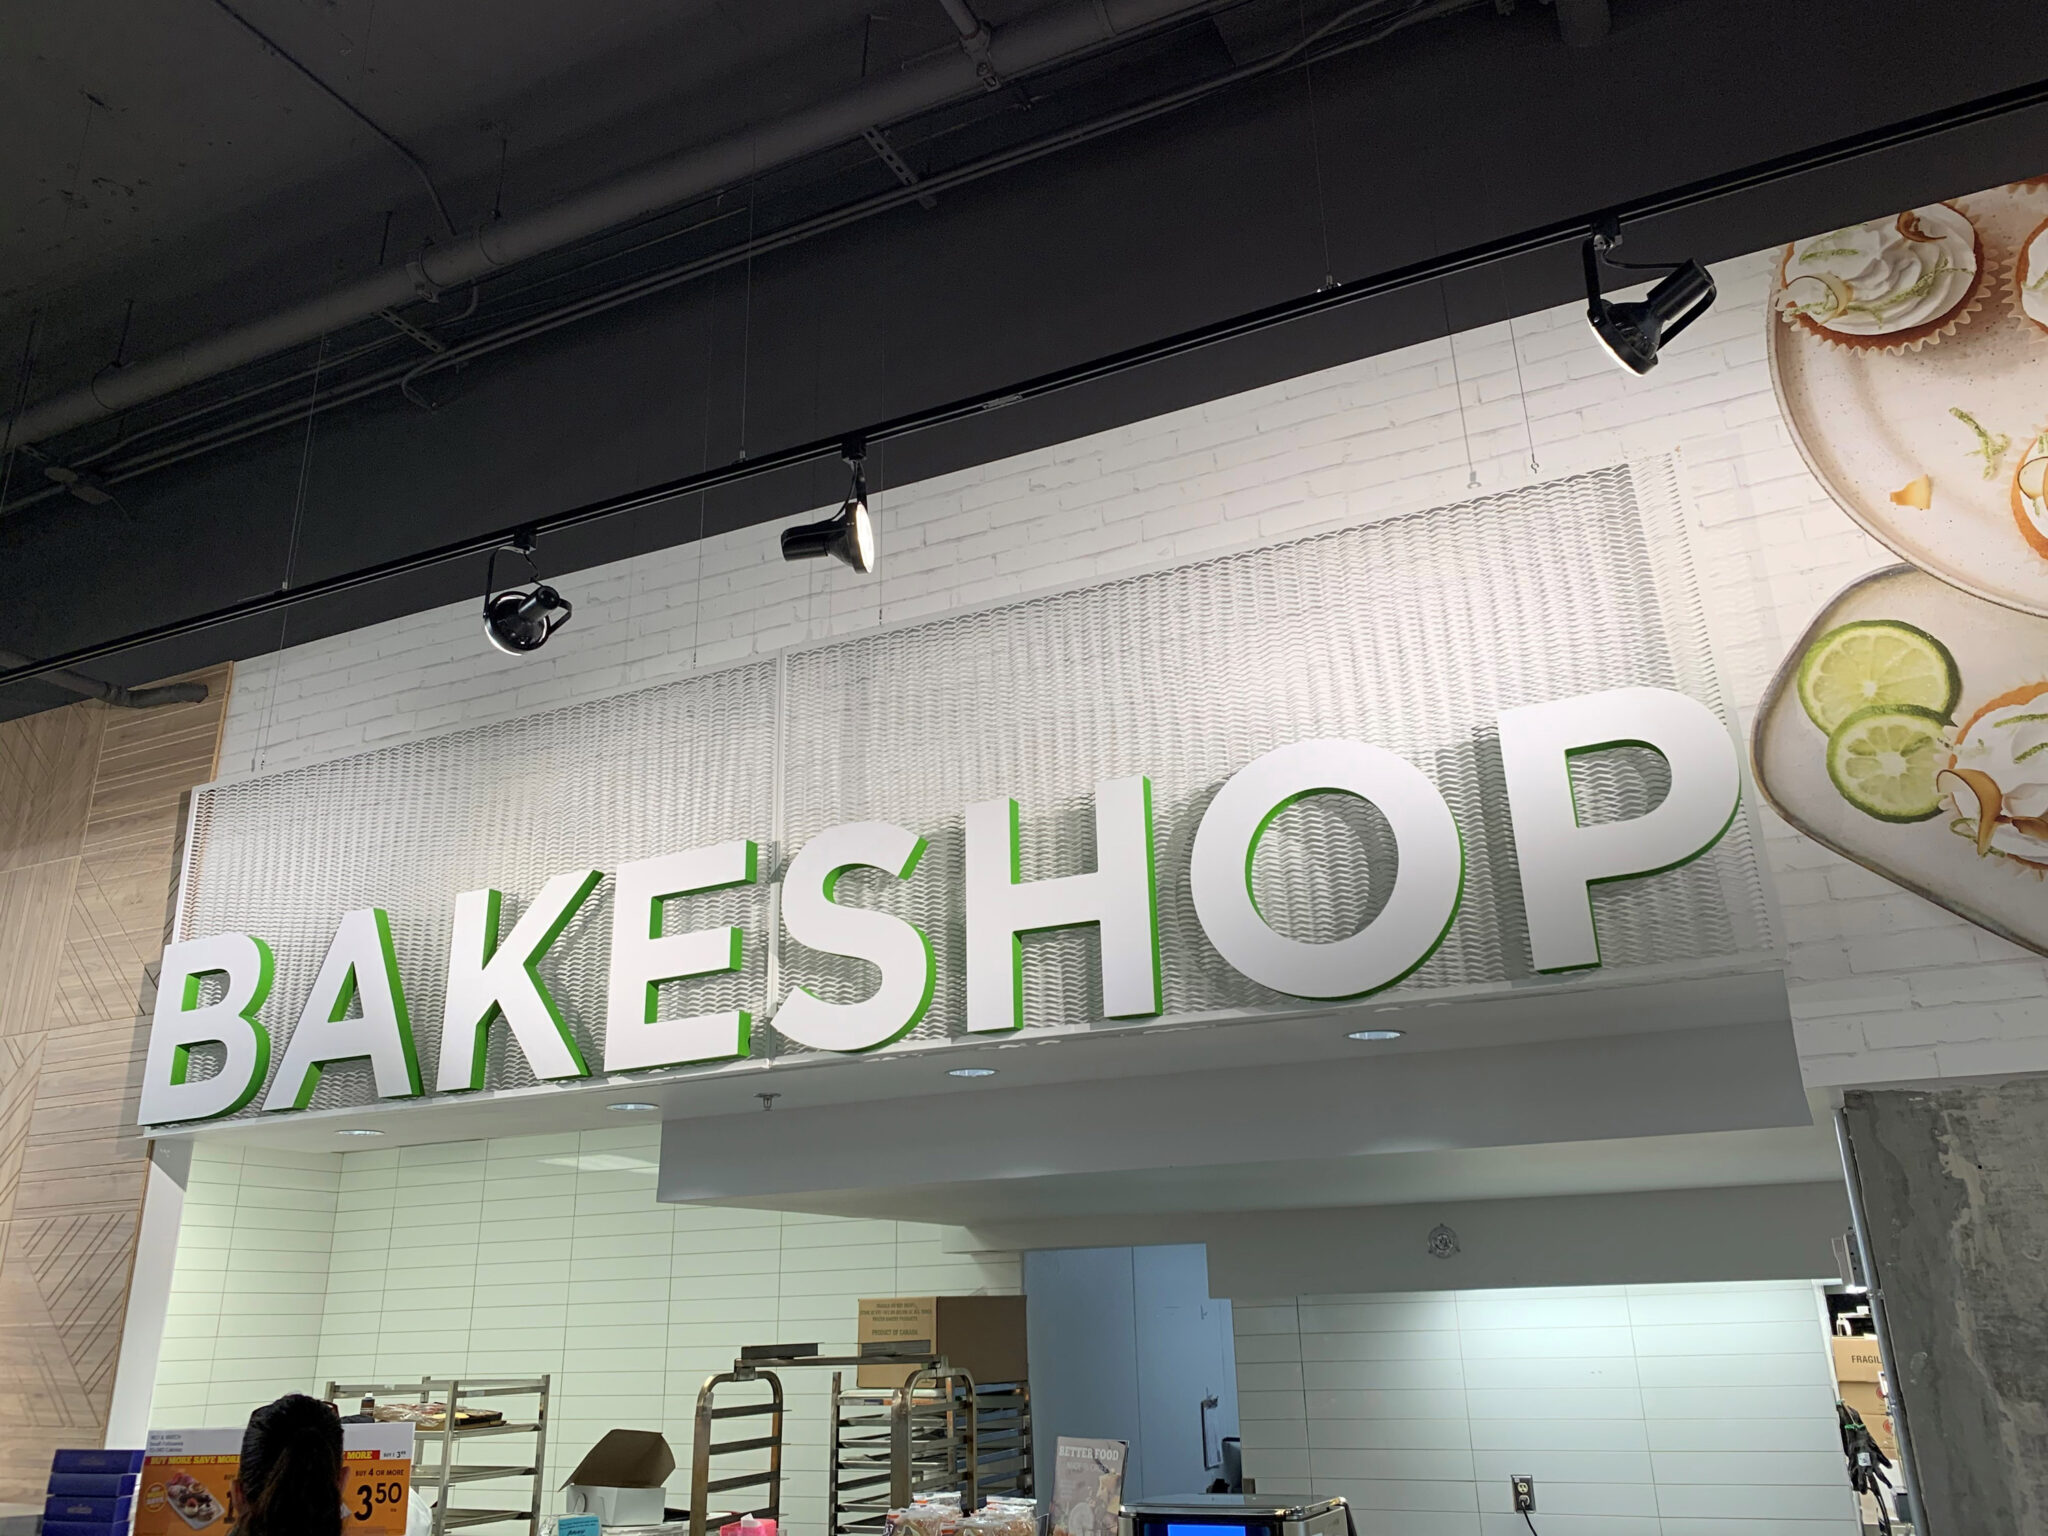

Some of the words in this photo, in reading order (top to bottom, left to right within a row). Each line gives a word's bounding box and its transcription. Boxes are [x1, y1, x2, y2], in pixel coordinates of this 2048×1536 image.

[138, 686, 1742, 1126] BAKESHOP
[1852, 1355, 1882, 1364] FRAGIL
[347, 1451, 372, 1459] MORE
[1059, 1445, 1093, 1458] BETTER
[1094, 1449, 1119, 1460] FOOD
[168, 1456, 192, 1464] MORE
[193, 1455, 216, 1463] SAVE
[368, 1468, 373, 1476] 4
